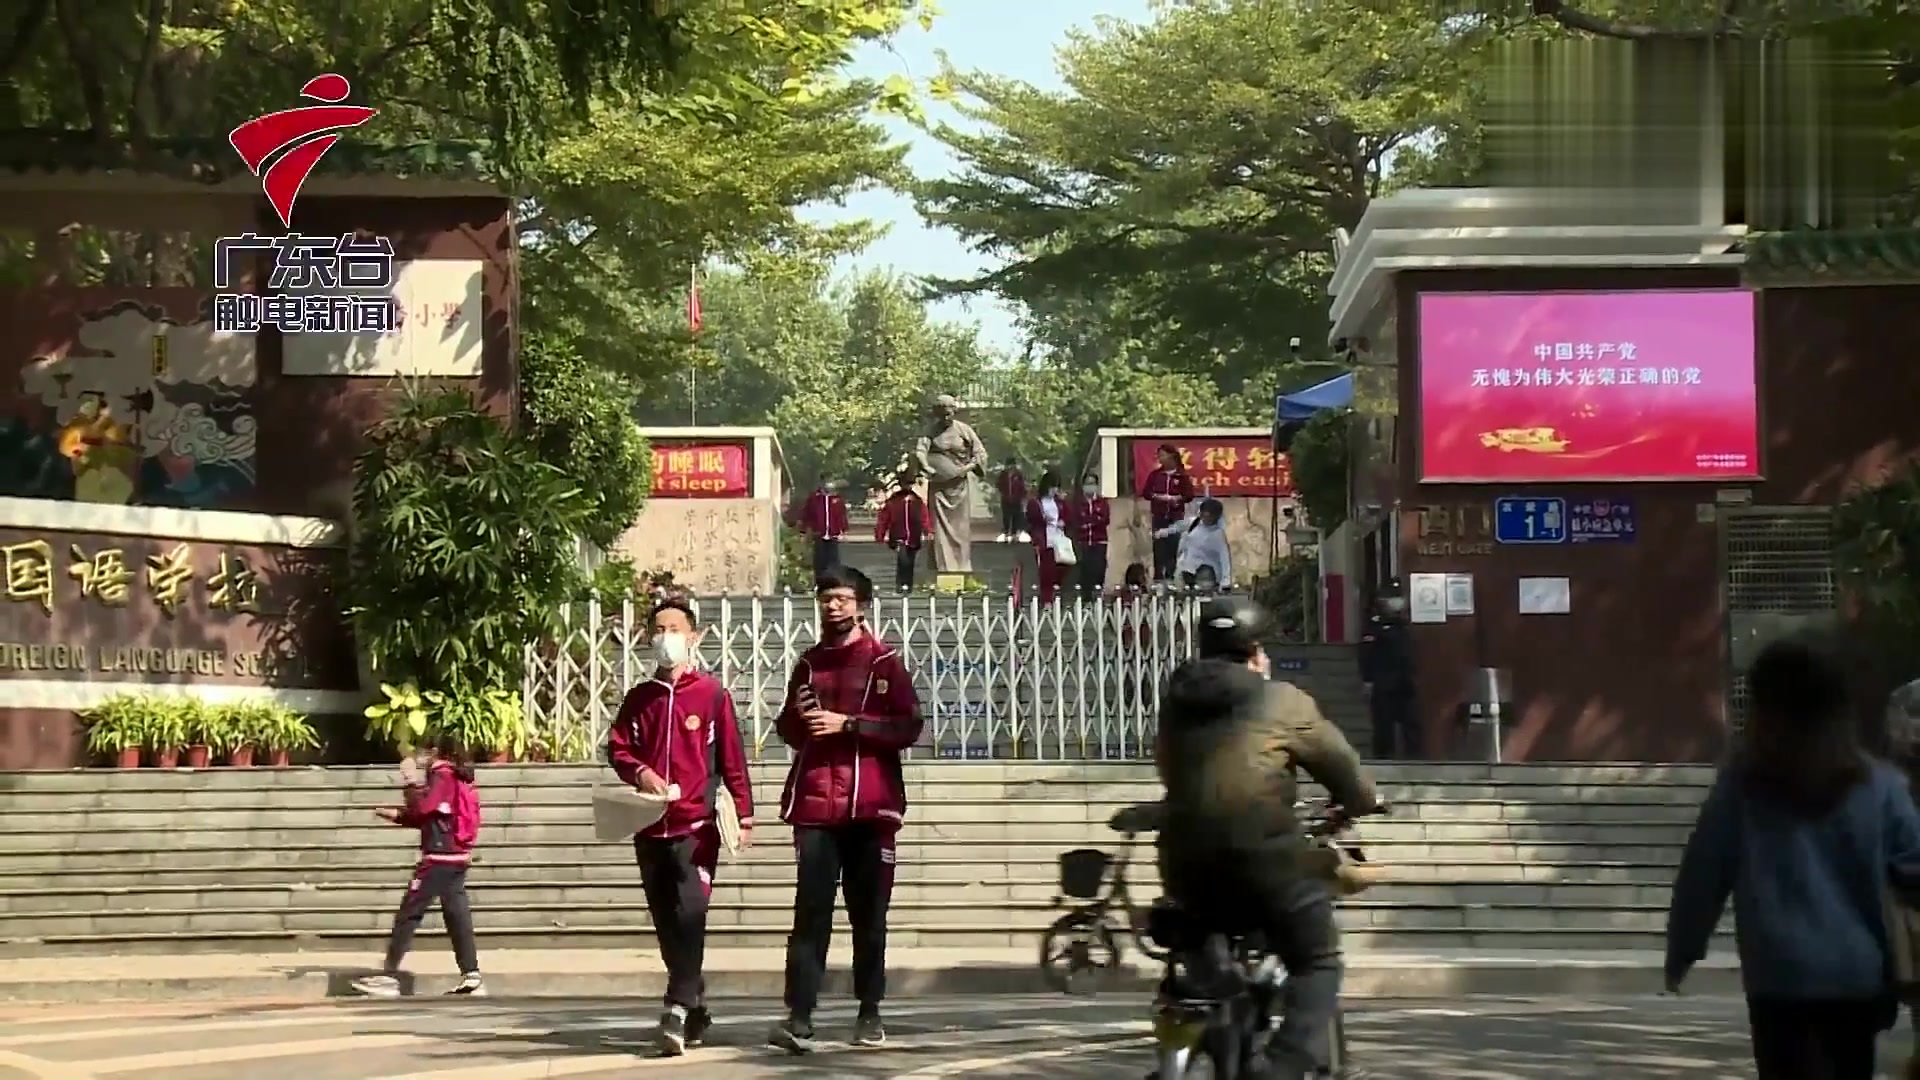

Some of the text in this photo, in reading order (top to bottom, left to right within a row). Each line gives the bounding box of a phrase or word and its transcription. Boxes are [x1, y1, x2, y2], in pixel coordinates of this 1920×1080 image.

[1534, 342, 1637, 362] 中国共产党
[1471, 367, 1702, 387] 无愧为伟大光荣正确的党
[669, 475, 727, 492] sleep
[99, 645, 225, 675] LANGUAGE
